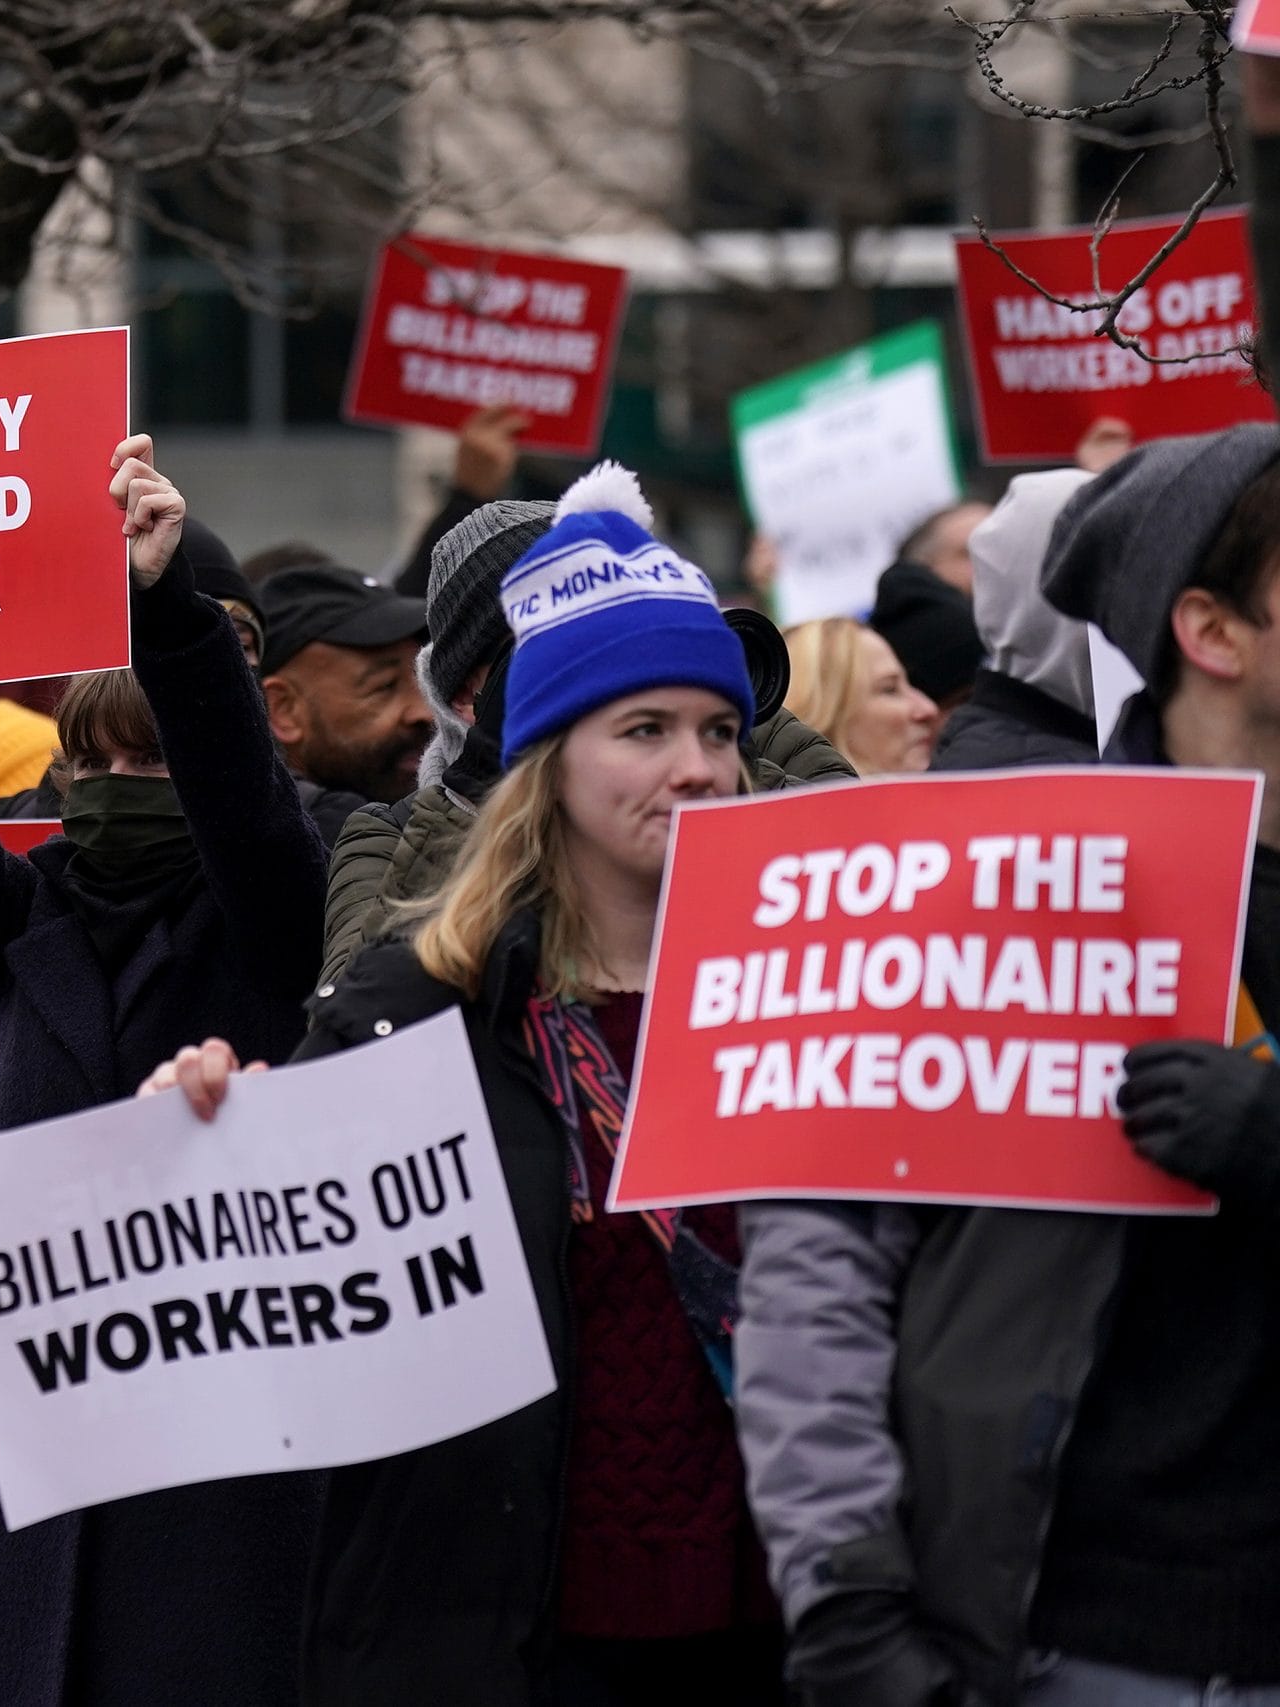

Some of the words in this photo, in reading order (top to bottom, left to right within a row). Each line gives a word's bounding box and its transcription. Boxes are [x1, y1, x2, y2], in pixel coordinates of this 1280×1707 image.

[1157, 275, 1242, 327] OFF
[551, 562, 683, 607] MONKYS
[752, 841, 950, 928] STOP
[967, 836, 1128, 912] THE
[690, 935, 1181, 1029] BILLIONAIRE
[715, 1034, 1126, 1118] TAKEOVER
[371, 1133, 475, 1231] OUT
[17, 1272, 391, 1394] WORKERS
[404, 1235, 485, 1317] IN
